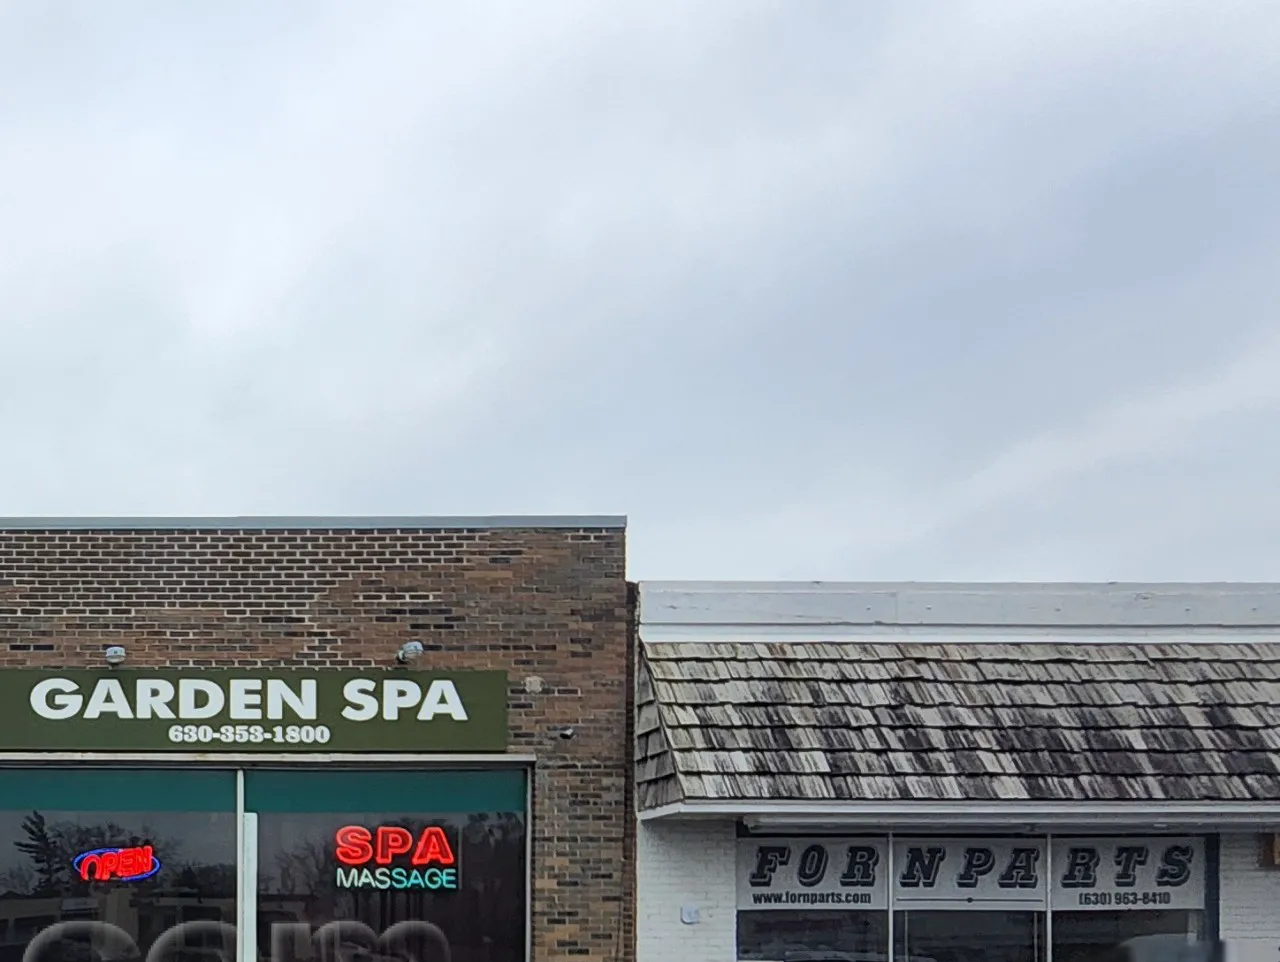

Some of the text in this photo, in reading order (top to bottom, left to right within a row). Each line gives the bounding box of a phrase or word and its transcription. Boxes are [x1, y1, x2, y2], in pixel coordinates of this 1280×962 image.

[29, 678, 468, 721] GARDEN SPA
[168, 725, 331, 744] 630-353-1800
[335, 824, 456, 866] SPA
[336, 867, 457, 890] MASSAGE
[752, 891, 872, 905] www.fornparts.com
[1114, 892, 1171, 905] 963-8410
